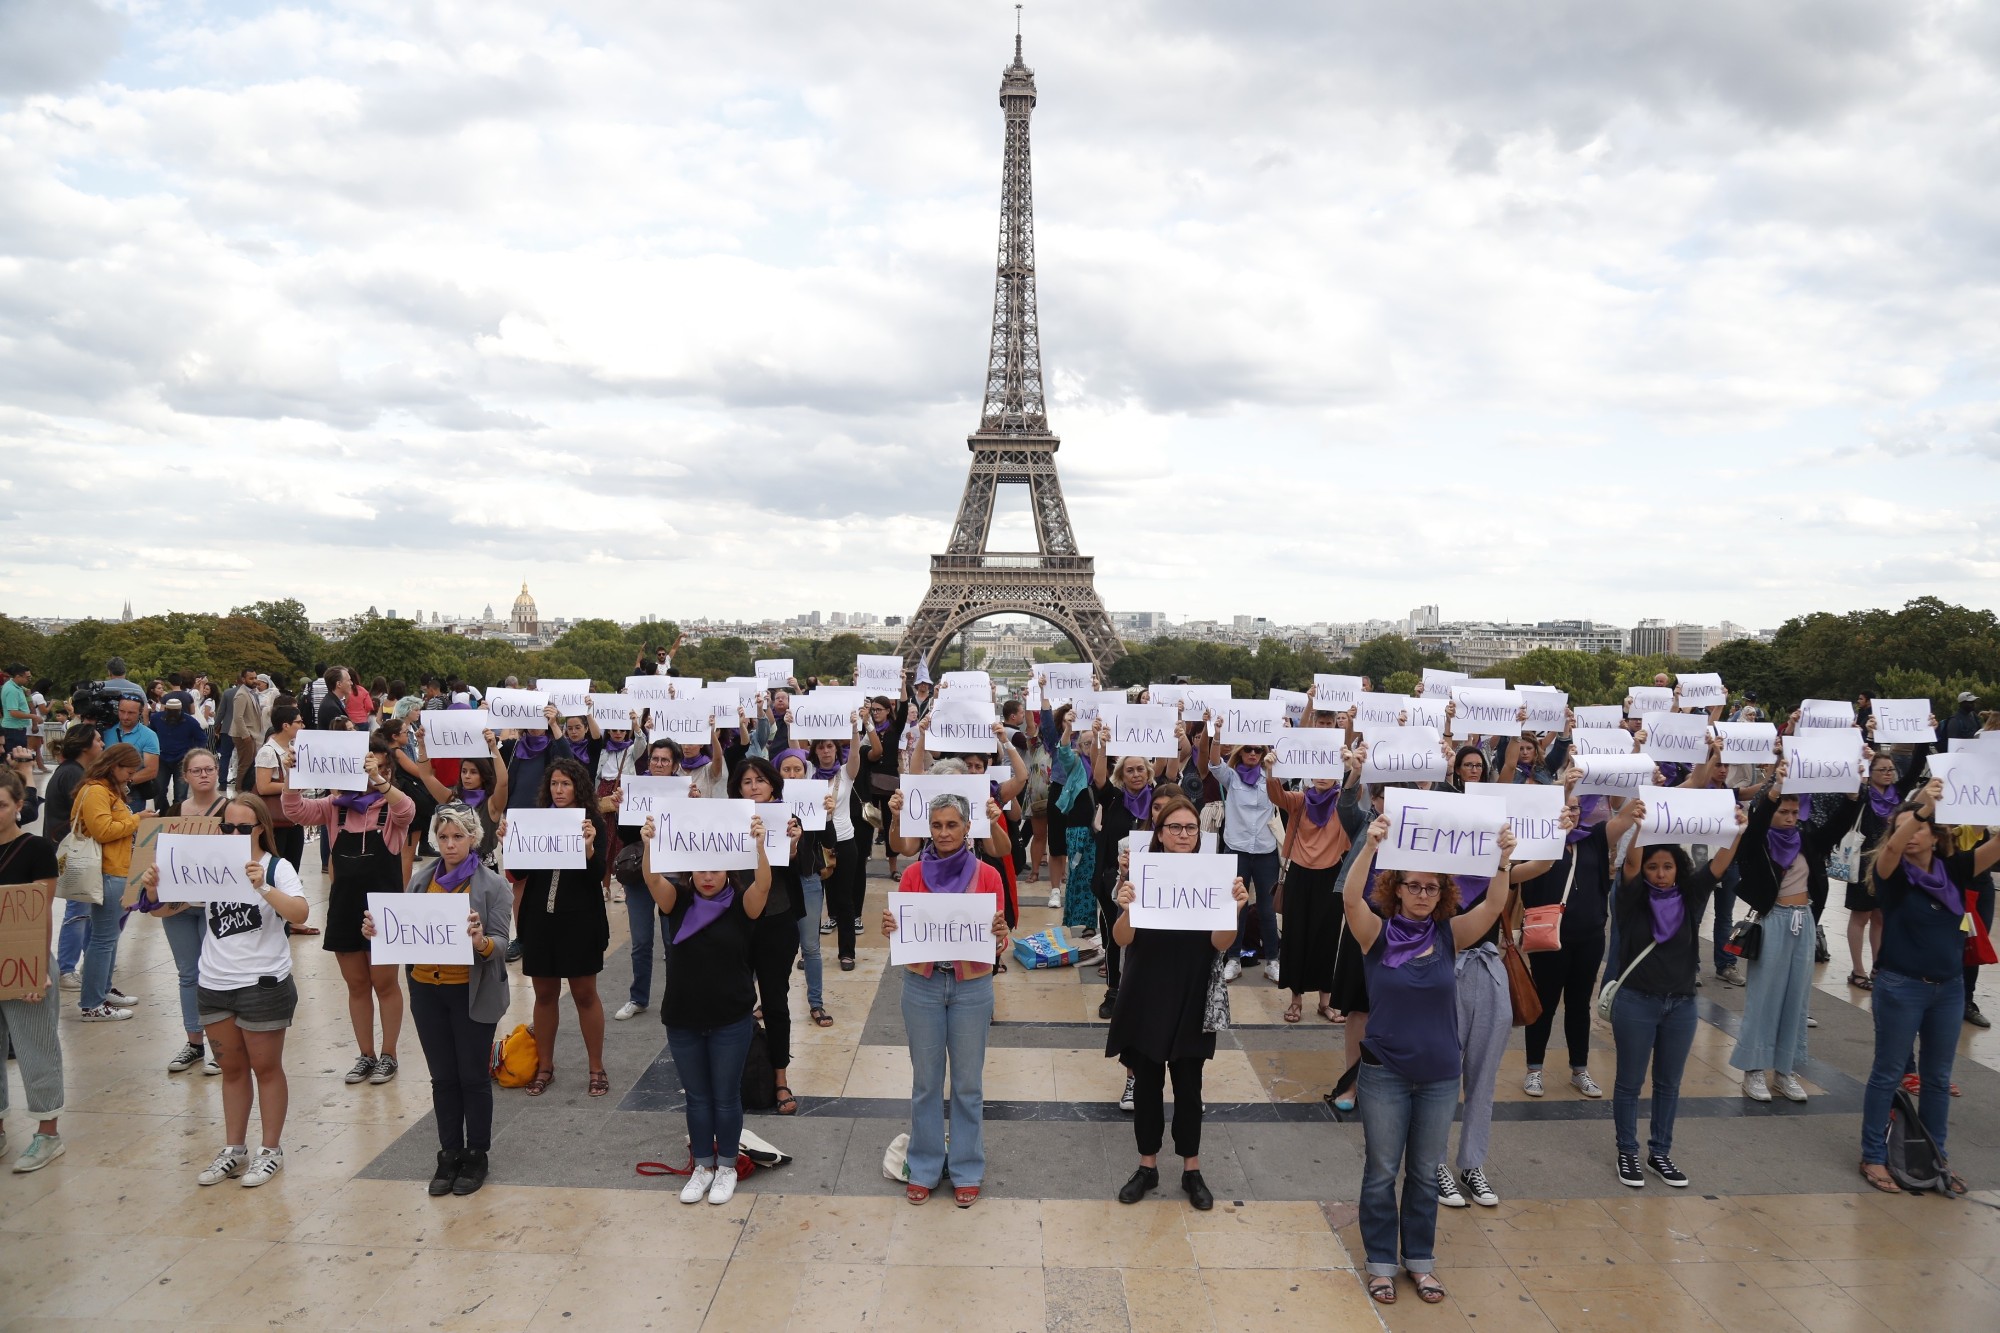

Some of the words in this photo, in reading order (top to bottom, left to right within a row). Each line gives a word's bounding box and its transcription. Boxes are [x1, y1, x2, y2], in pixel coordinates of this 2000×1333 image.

[1050, 672, 1084, 689] FEMME
[1317, 683, 1354, 702] NATHALI
[1680, 682, 1720, 698] CHANTAL
[491, 697, 543, 718] CORALIE
[654, 710, 703, 733] MICHÈLE
[1228, 710, 1272, 733] MAYIE
[1880, 707, 1923, 731] FEMME
[430, 719, 473, 746] LEILA
[929, 710, 994, 739] CHRISTELLE
[1115, 715, 1165, 743] LAURA
[1648, 723, 1702, 750] YVONNE
[297, 744, 363, 774] MARTINE
[1275, 737, 1338, 766] CATHERINE
[1372, 741, 1435, 771] CHLOÉ
[1789, 749, 1851, 779] MÉLISSA
[1581, 763, 1652, 788] LUCETTE
[1947, 768, 2000, 806] SARA
[1398, 805, 1495, 856] FEMME
[1507, 815, 1560, 840] THILDE
[1656, 801, 1725, 835] MAGUY
[508, 821, 583, 853] ANTOINETTE
[658, 813, 751, 853] MARIANNE
[171, 847, 237, 885] IRINA
[1143, 865, 1222, 910] ELIANE
[0, 889, 45, 924] ARD
[218, 908, 252, 937] BACK
[384, 907, 457, 945] DENISE
[900, 905, 988, 944] EUPHÉMIE
[0, 956, 38, 987] ON
